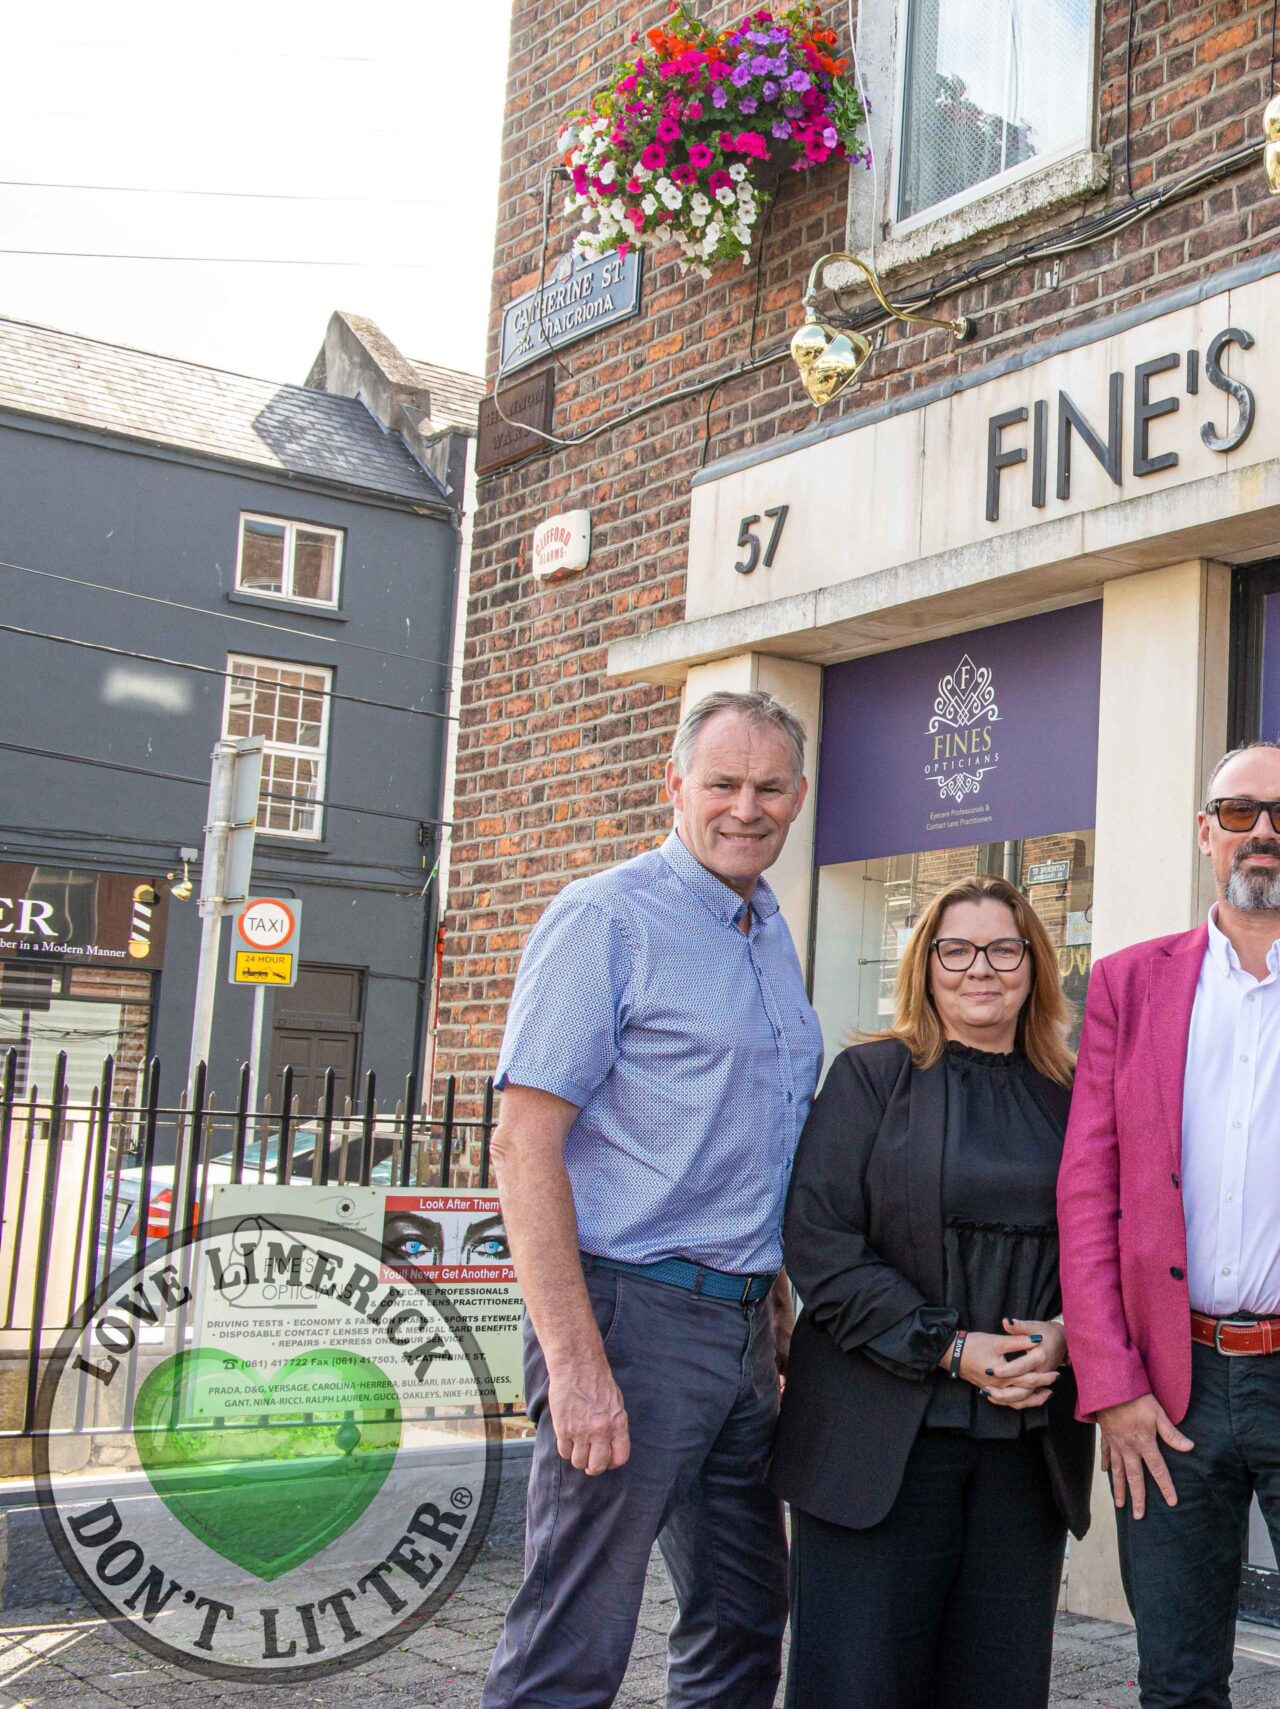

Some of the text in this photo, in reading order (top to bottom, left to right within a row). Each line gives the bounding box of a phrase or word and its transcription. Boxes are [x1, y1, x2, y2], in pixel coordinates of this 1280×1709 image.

[514, 260, 625, 333] CATHERINE ST.
[985, 326, 1255, 522] FINE'S
[535, 527, 571, 557] CLIFFORD
[733, 504, 789, 574] 57
[961, 666, 970, 689] F
[933, 726, 992, 760] FINES
[924, 752, 999, 774] OPTICIANS
[248, 917, 284, 932] TAXI
[20, 940, 30, 950] in
[42, 942, 83, 955] Modern
[86, 945, 126, 958] Manner
[419, 1198, 500, 1210] Look After Them
[264, 1257, 314, 1273] FINE'S
[410, 1269, 439, 1279] Never
[441, 1269, 459, 1279] Get
[461, 1268, 499, 1279] Another
[262, 1283, 353, 1300] OPTICIANS
[389, 1288, 509, 1297] EYECARE PROFESSIONALS
[370, 1300, 377, 1308] &
[380, 1300, 424, 1308] CONTACT
[427, 1299, 450, 1307] LENS
[207, 1320, 250, 1328] DRIVING
[253, 1319, 284, 1327] TESTS
[293, 1318, 342, 1327] ECONOMY
[345, 1318, 351, 1326] &
[355, 1317, 395, 1325] FASHION
[398, 1316, 435, 1324] FRAMES
[444, 1315, 479, 1323] SPORTS
[219, 1330, 281, 1339] DISPOSABLE
[284, 1329, 330, 1337] CONTACT
[333, 1328, 369, 1336] LENSES
[406, 1326, 446, 1334] MEDICAL
[449, 1325, 473, 1333] CARD
[475, 1324, 518, 1332] BENEFITS
[278, 1339, 319, 1347] REPAIRS
[329, 1338, 372, 1346] EXPRESS
[375, 1337, 394, 1345] ONE
[397, 1336, 423, 1344] HOUR
[241, 1360, 267, 1369] (061)
[270, 1358, 307, 1367] 417722
[311, 1358, 329, 1366] Fax
[332, 1357, 357, 1366] (061)
[415, 1353, 471, 1362] CATHERINE
[208, 1386, 242, 1395] PRADA,
[245, 1385, 267, 1394] D&G,
[269, 1383, 310, 1392] VERSAGE,
[484, 1376, 512, 1384] GUESS,
[224, 1399, 252, 1408] GANT,
[306, 1396, 334, 1404] RALPH
[443, 1389, 496, 1398] NIKE-FLEXON
